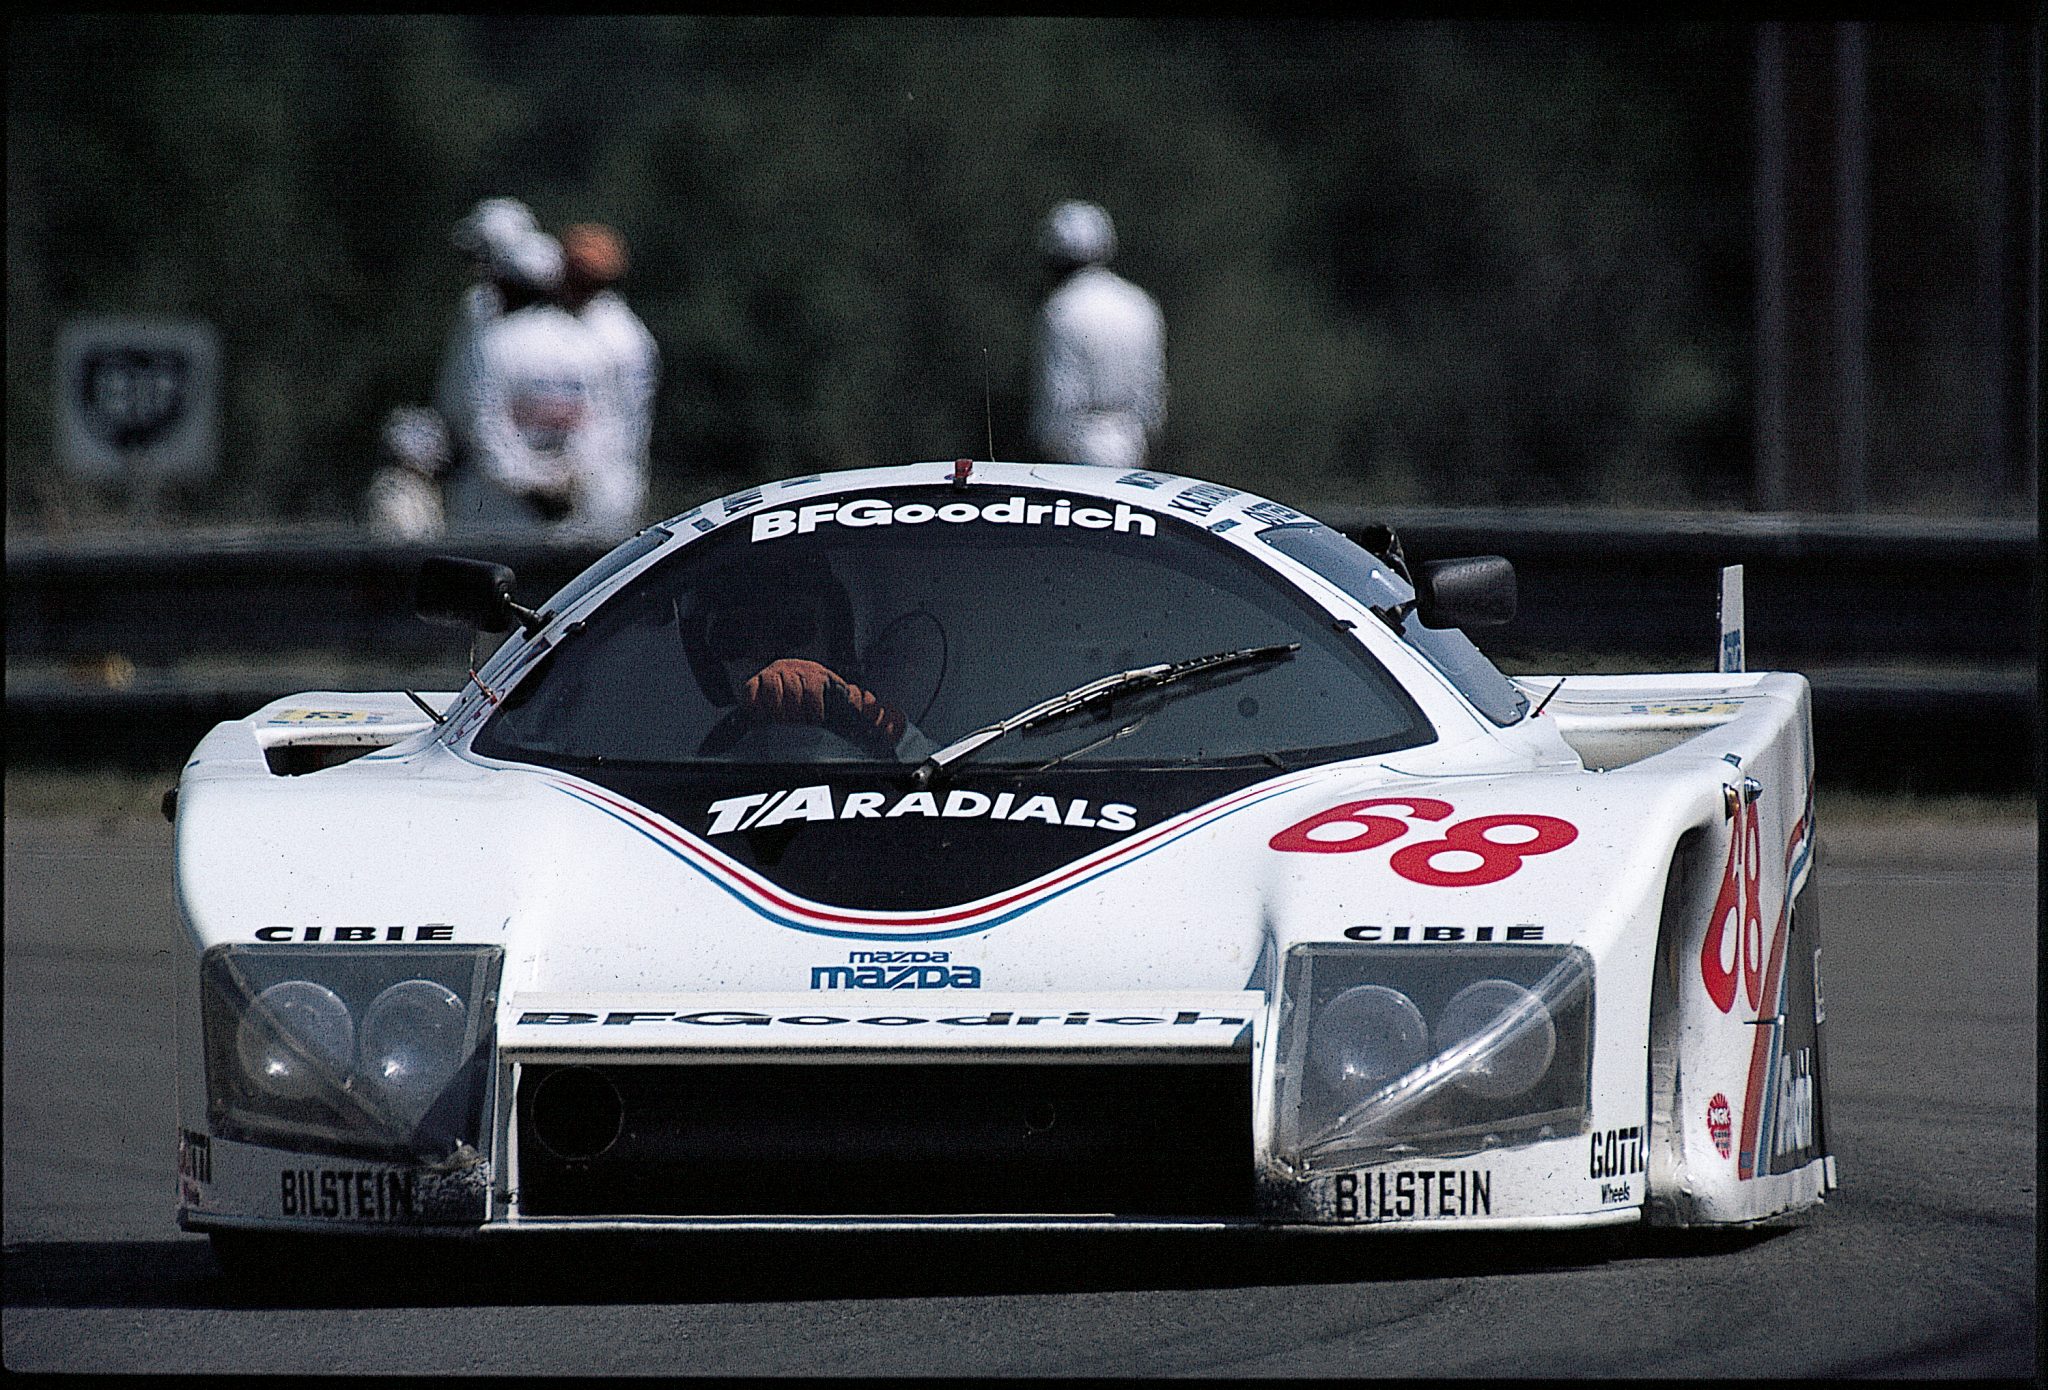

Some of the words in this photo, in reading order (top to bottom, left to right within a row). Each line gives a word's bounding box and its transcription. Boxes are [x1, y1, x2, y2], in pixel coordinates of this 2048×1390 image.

[751, 497, 1157, 543] BFGoodrich
[707, 785, 832, 836] T/A
[840, 791, 1138, 832] RADIALS
[1269, 797, 1578, 887] 68
[517, 1011, 1245, 1025] BFGoodrich
[1710, 1107, 1730, 1127] NGK
[281, 1169, 420, 1219] BILSTEIN
[1336, 1170, 1491, 1217] BILSTEIN
